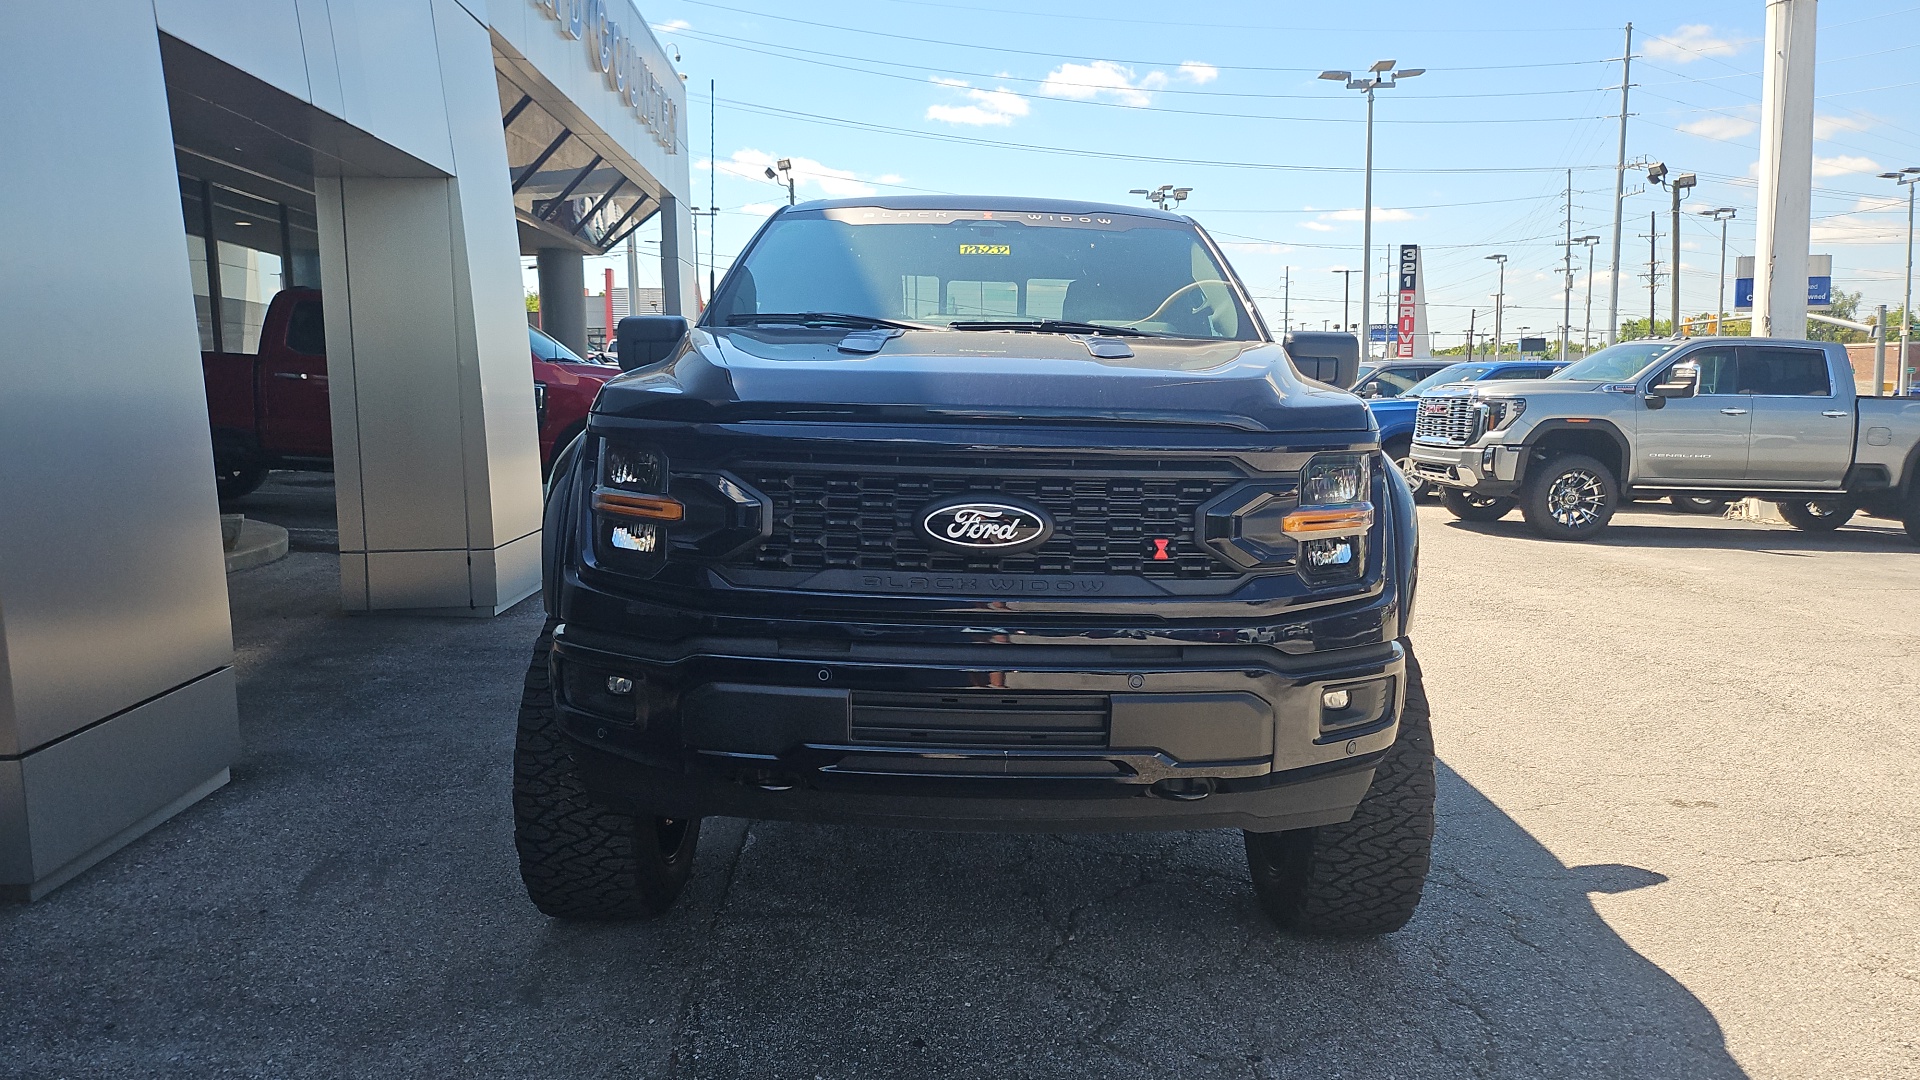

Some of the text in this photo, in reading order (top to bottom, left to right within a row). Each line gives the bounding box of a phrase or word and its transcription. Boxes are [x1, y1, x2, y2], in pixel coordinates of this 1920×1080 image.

[1027, 214, 1111, 224] WIDOW
[946, 509, 1020, 539] Ford
[861, 575, 1104, 592] BLACK WIDOW
